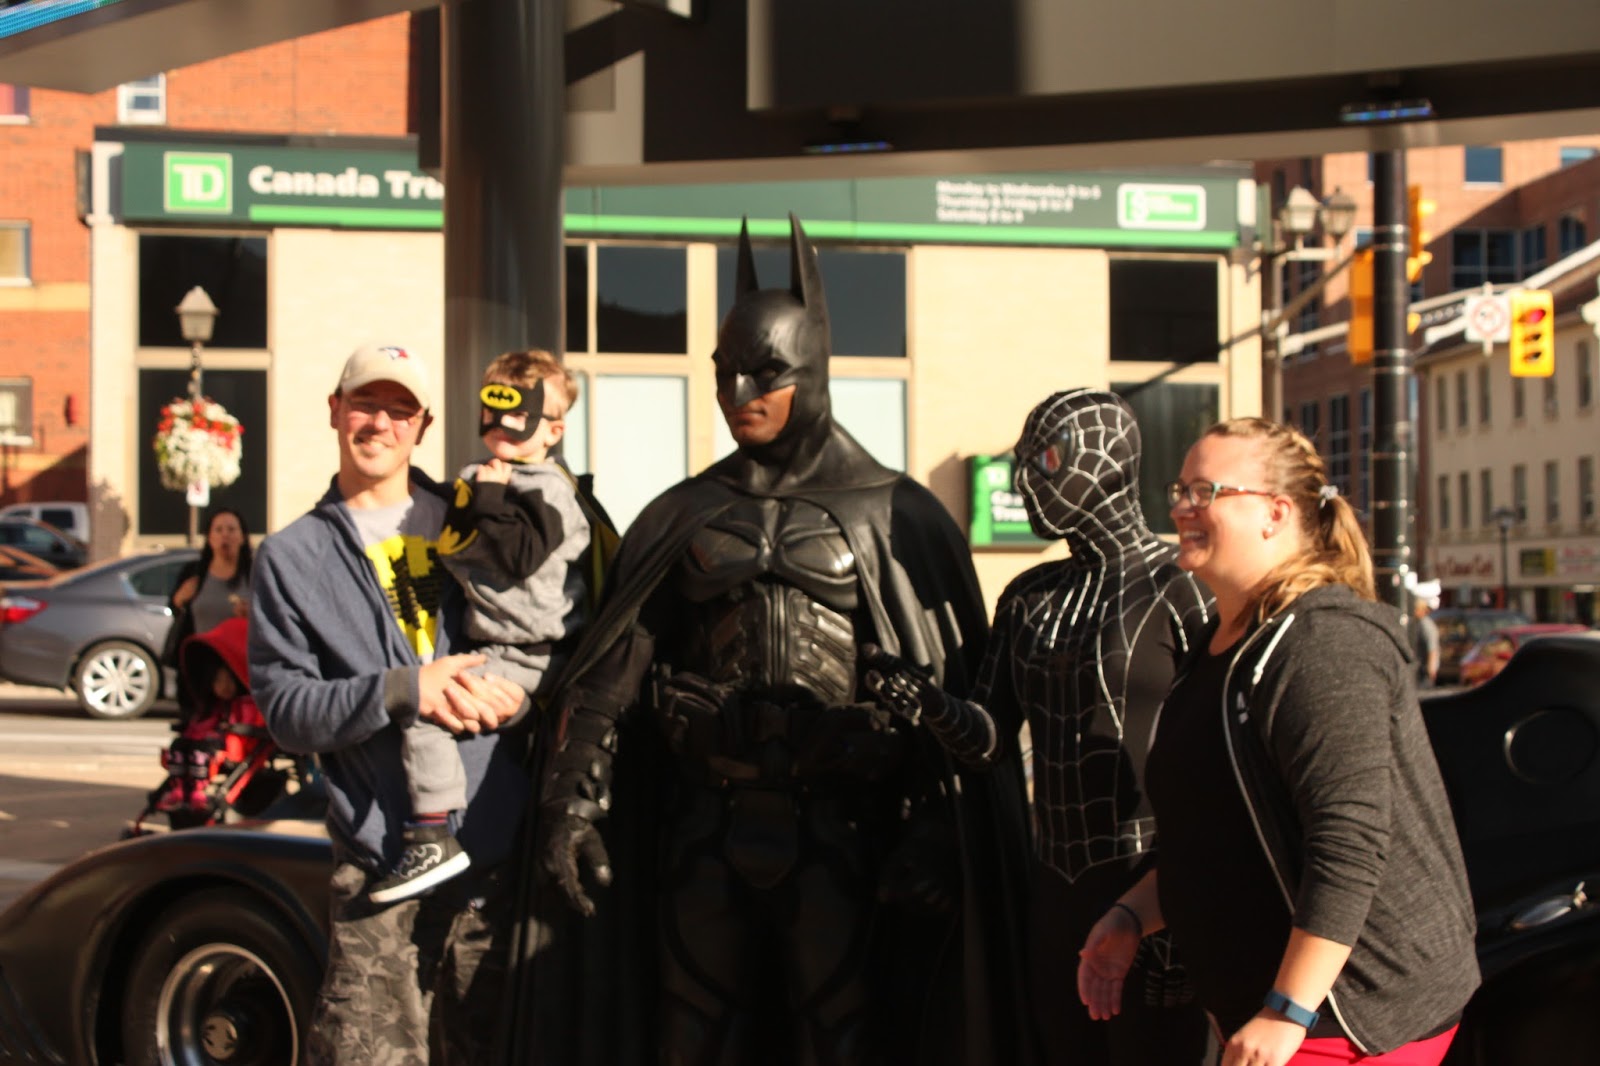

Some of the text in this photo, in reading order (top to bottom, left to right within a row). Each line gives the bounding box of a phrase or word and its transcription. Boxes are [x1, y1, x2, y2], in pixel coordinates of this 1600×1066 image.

[172, 163, 446, 201] TD Canada Tru
